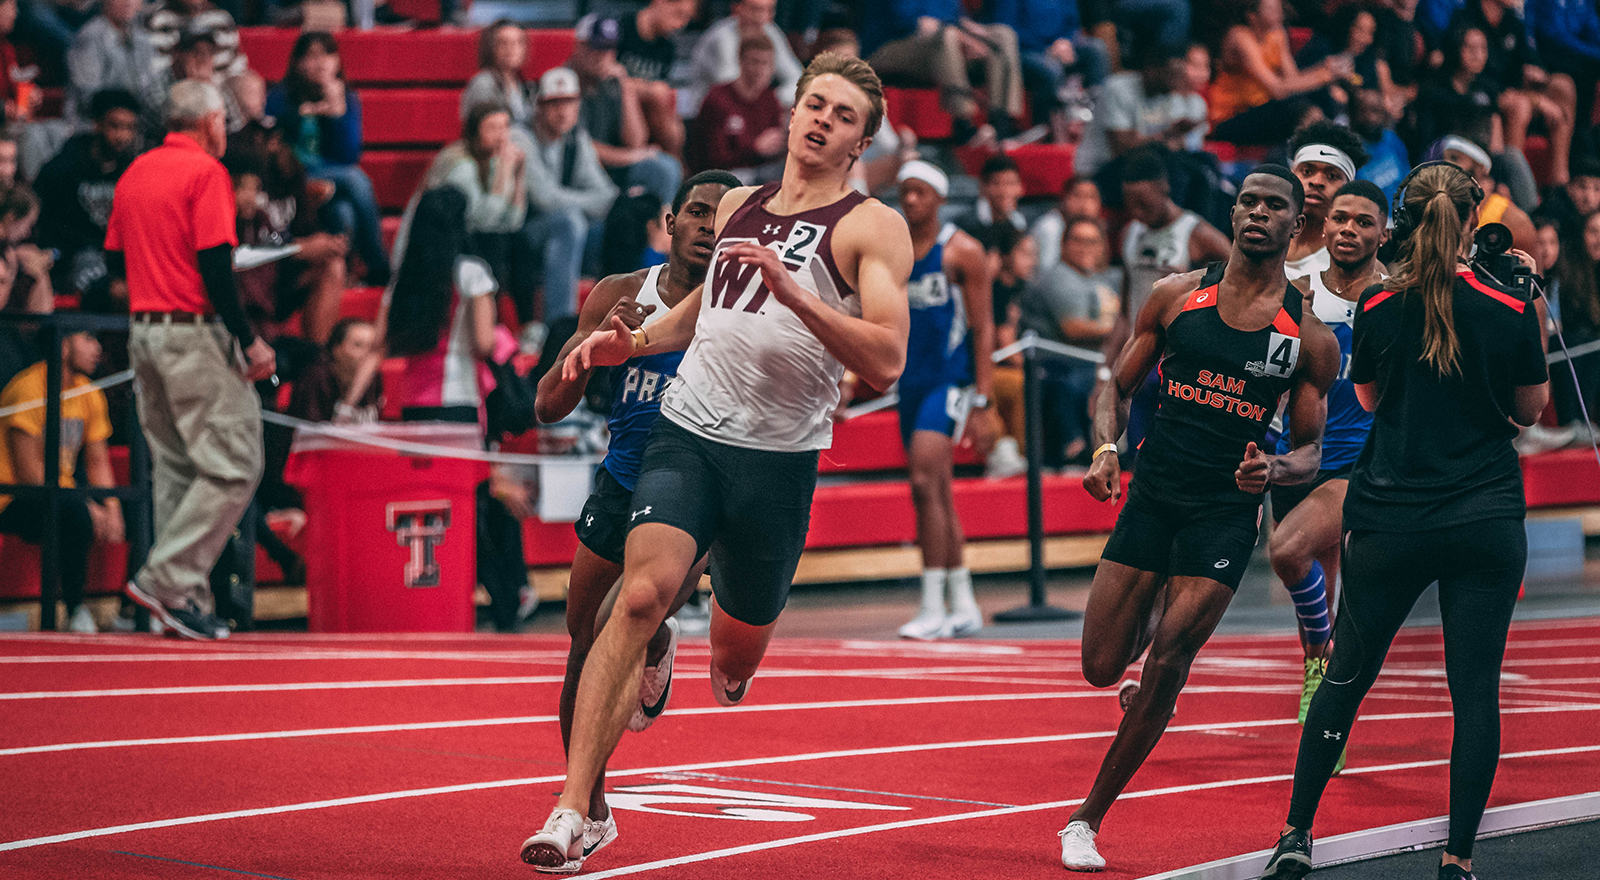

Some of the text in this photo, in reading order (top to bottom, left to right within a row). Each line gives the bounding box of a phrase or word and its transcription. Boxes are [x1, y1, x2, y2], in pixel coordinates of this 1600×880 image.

[783, 225, 818, 263] 2
[1269, 337, 1293, 375] 4
[1167, 379, 1267, 422] HOUSTON
[1197, 369, 1246, 395] SAM
